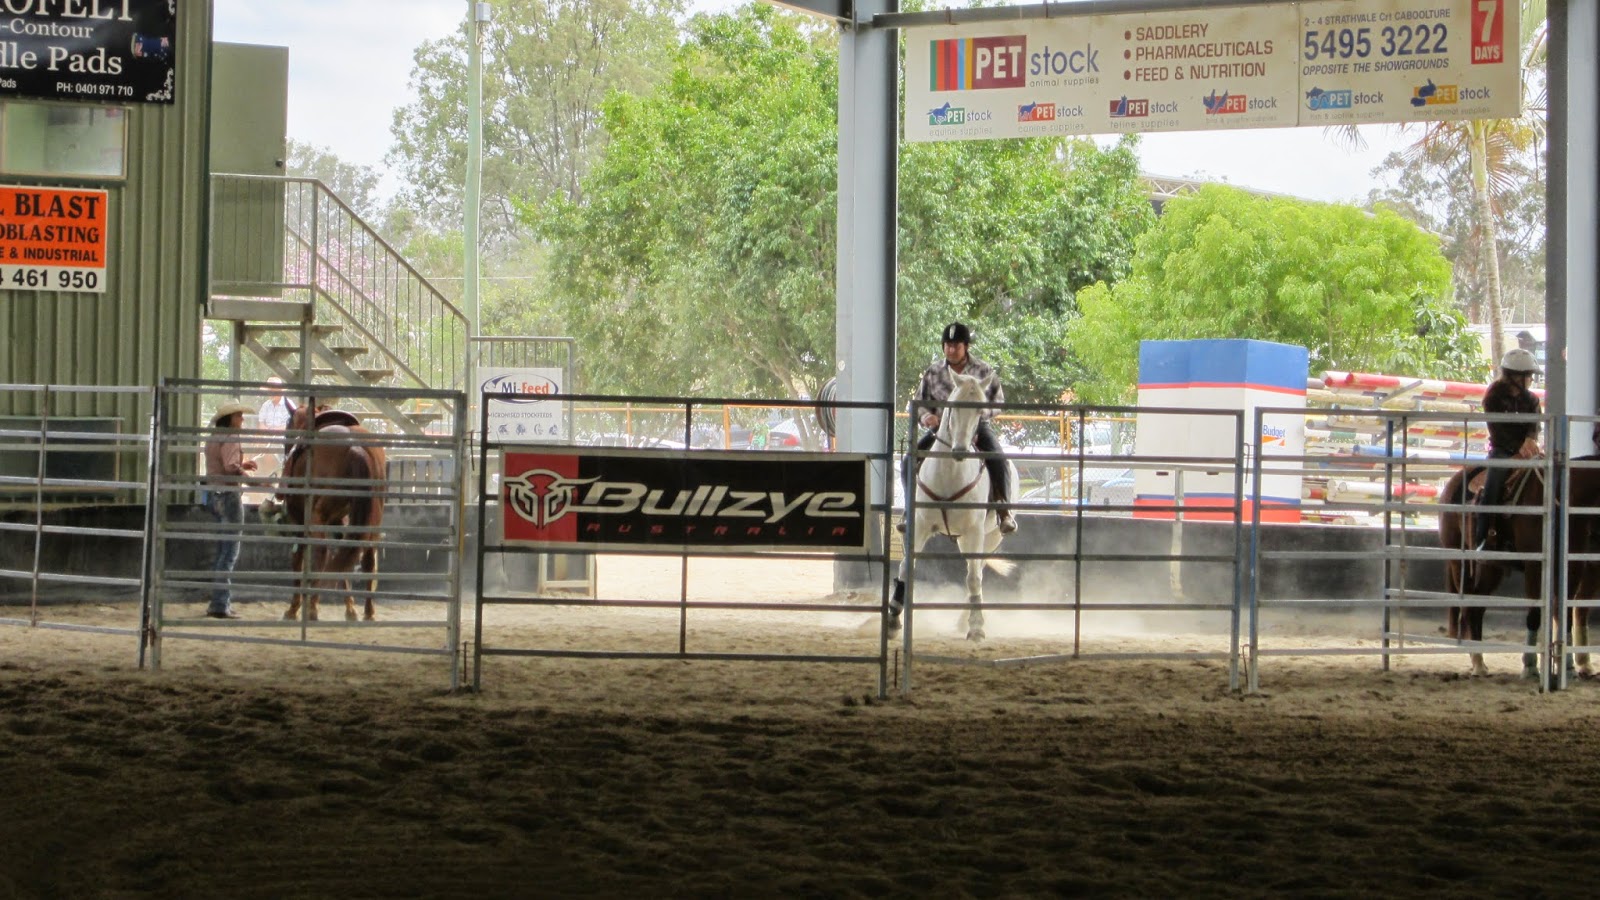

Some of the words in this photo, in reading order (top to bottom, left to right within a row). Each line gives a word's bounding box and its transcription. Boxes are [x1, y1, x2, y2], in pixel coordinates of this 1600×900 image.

[0, 0, 133, 21] OFELT
[1304, 18, 1310, 26] 2
[1317, 17, 1323, 25] 4
[1325, 13, 1377, 25] STRATHVALE
[1394, 8, 1451, 21] CABOOLTURE
[1478, 1, 1497, 42] 7
[1136, 23, 1209, 41] SADDLERY
[1136, 40, 1274, 61] PHARMACEUTICALS
[1304, 27, 1372, 60] 5495
[1381, 23, 1448, 57] 3222
[47, 46, 122, 75] Pads
[975, 46, 1022, 79] PET
[1030, 43, 1100, 76] stock
[1475, 45, 1500, 61] DAYS
[1135, 66, 1169, 81] FEED
[1174, 66, 1184, 80] &
[1190, 62, 1266, 79] NUTRITION
[1303, 63, 1349, 76] OPPOSITE
[1353, 62, 1371, 73] THE
[1374, 58, 1449, 72] SHOWGROUNDS
[56, 82, 74, 93] PH:
[75, 83, 97, 94] 0401
[99, 84, 115, 95] 971
[117, 86, 134, 97] 710
[1030, 79, 1060, 88] animal
[1064, 76, 1100, 87] supplies
[1354, 91, 1384, 105] stock
[1460, 86, 1490, 100] stock
[1057, 105, 1084, 118] stock
[1150, 100, 1178, 114] stock
[1248, 96, 1278, 110] stock
[966, 110, 992, 122] stock
[15, 193, 100, 220] BLAST
[10, 246, 18, 259] &
[24, 248, 98, 262] INDUSTRIAL
[12, 268, 48, 287] 461
[58, 270, 98, 289] 950
[1263, 424, 1286, 438] Budget
[580, 482, 860, 523] Bullzye
[586, 523, 846, 536] AUSTRALIA
